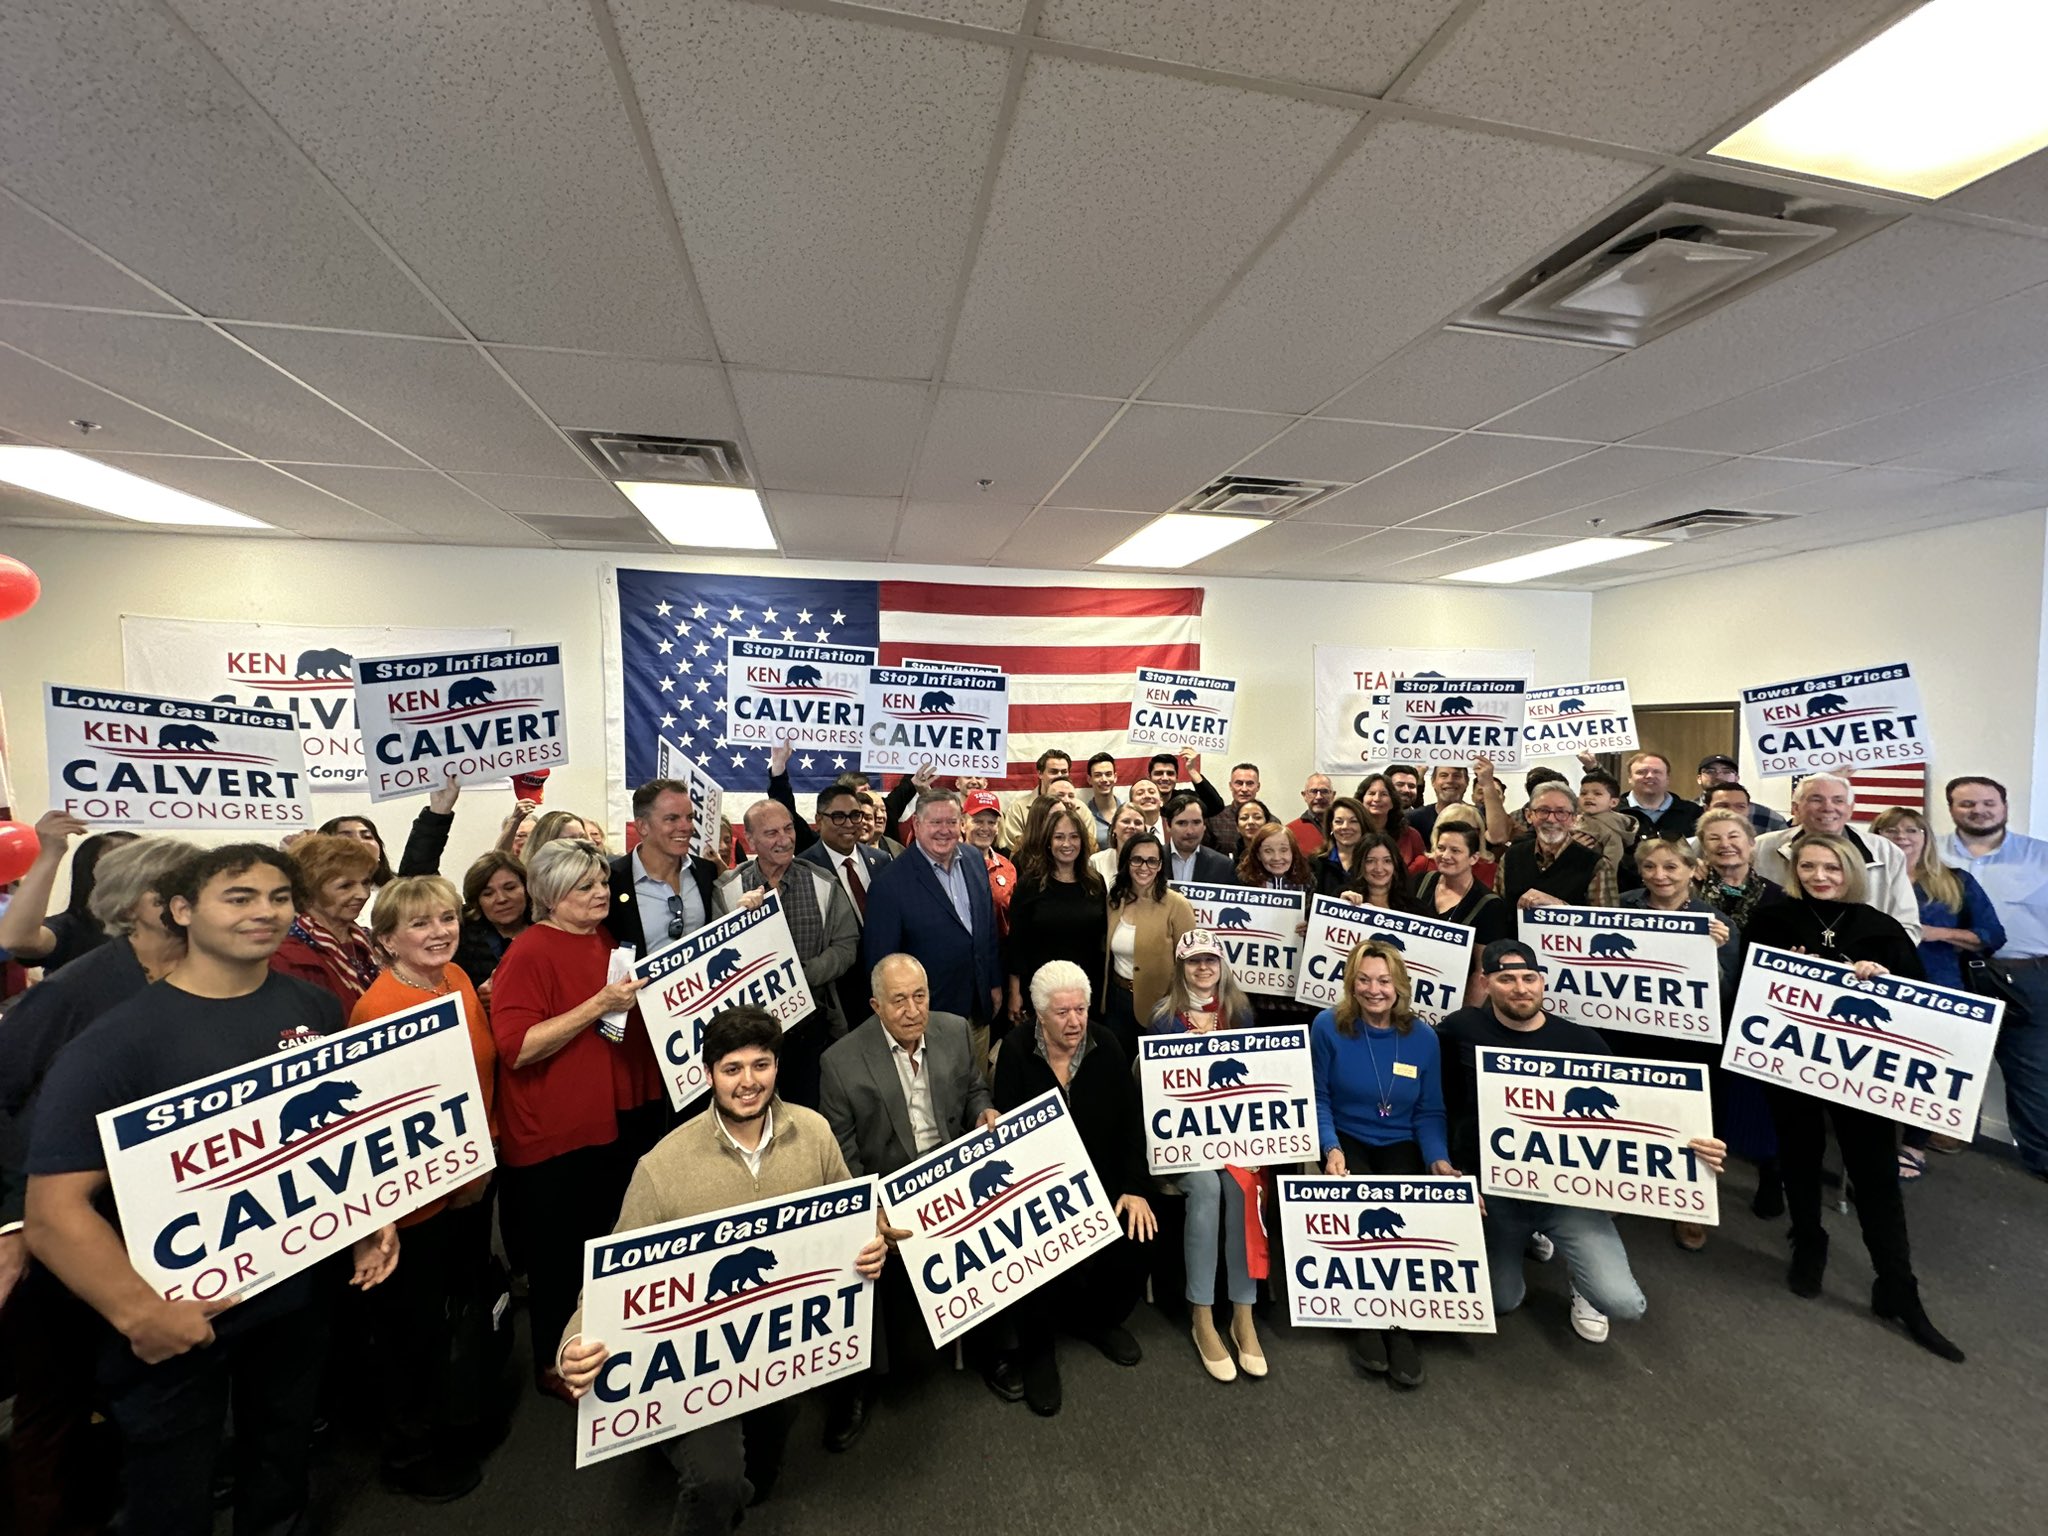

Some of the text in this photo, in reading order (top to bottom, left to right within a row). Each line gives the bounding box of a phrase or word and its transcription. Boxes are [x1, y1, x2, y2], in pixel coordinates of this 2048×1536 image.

[228, 652, 286, 674] KEN
[376, 652, 548, 678] Stop Inflation
[742, 643, 865, 663] Stop Inflation
[747, 666, 780, 683] KEN
[879, 672, 996, 688] Stop Inflation
[1146, 672, 1229, 689] Stop Inflation
[1402, 682, 1516, 692] Stop Inflation
[1748, 668, 1903, 701] Lower Gas Prices
[388, 689, 440, 713] KEN
[883, 694, 915, 709] KEN
[1146, 688, 1170, 702] KEN
[1526, 683, 1622, 700] ower Gas Prices
[60, 691, 151, 714] Lower
[160, 702, 205, 720] Gas
[214, 708, 288, 728] Prices
[1406, 700, 1435, 713] KEN
[1528, 704, 1554, 716] KEN
[1763, 704, 1800, 722] KEN
[84, 721, 148, 744] KEN
[734, 724, 766, 738] FOR
[870, 722, 1001, 750] CALVERT
[1136, 710, 1228, 736] CALVERT
[1394, 724, 1518, 746] CALVERT
[1523, 717, 1628, 740] CALVERT
[1758, 715, 1917, 755] CALVERT
[376, 710, 560, 765] CALVERT
[1133, 729, 1224, 748] FOR CONGRESS
[1525, 736, 1632, 754] FOR CONGRESS
[380, 767, 430, 791] FOR
[443, 742, 561, 777] CONGRESS
[868, 750, 999, 769] FOR CONGRESS
[1393, 747, 1516, 762] FOR CONGRESS
[1762, 742, 1924, 771] FOR CONGRESS
[63, 759, 298, 799] CALVERT
[64, 799, 304, 820] FOR CONGRESS
[1179, 886, 1292, 906] Stop Inflation
[1320, 902, 1464, 944] Lower Gas Prices
[1534, 910, 1696, 931] Stop Inflation
[648, 902, 770, 978] Stop Inflation
[1326, 926, 1361, 944] KEN
[1541, 934, 1582, 954] KEN
[1224, 940, 1297, 970] VERT
[663, 973, 704, 1011] KEN
[1232, 970, 1294, 988] NGRESS
[1302, 982, 1336, 1002] FOR
[1758, 952, 1986, 1020] Lower Gas Prices
[1768, 982, 1823, 1012] KEN
[1542, 998, 1710, 1032] OR CONGRESS
[1148, 1035, 1300, 1058] Lower Gas Prices
[1740, 1015, 1973, 1101] CALVERT
[146, 1012, 440, 1132] Stop Inflation
[676, 1066, 701, 1095] FO
[1163, 1068, 1202, 1089] KEN
[1496, 1054, 1687, 1086] Stop Inflation
[1505, 1086, 1554, 1112] KEN
[1734, 1046, 1784, 1075] FOR
[1800, 1066, 1962, 1126] CONGRESS
[1152, 1098, 1308, 1140] CALVERT
[171, 1120, 266, 1183] KEN
[892, 1104, 1058, 1200] Lower Gas Prices
[1154, 1134, 1312, 1164] FOR CONGRESS
[1490, 1127, 1698, 1182] CALVERT
[153, 1092, 470, 1270] CALVERT
[1290, 1183, 1467, 1201] Lower Gas Prices
[1491, 1166, 1705, 1210] FOR CONGRESS
[281, 1140, 479, 1256] CONGRESS
[916, 1188, 966, 1232] KEN
[602, 1193, 863, 1273] Lower Gas Prices
[922, 1170, 1094, 1294] CALVERT
[1306, 1214, 1350, 1235] KEN
[935, 1287, 984, 1329] FOR
[992, 1211, 1109, 1293] CONGRESS
[1296, 1256, 1480, 1294] CALVERT
[623, 1273, 695, 1320] KEN
[1298, 1296, 1484, 1320] FOR CONGRESS
[593, 1282, 863, 1403] CALVERT
[591, 1401, 662, 1446] FOR
[684, 1335, 859, 1414] CONGRESS
